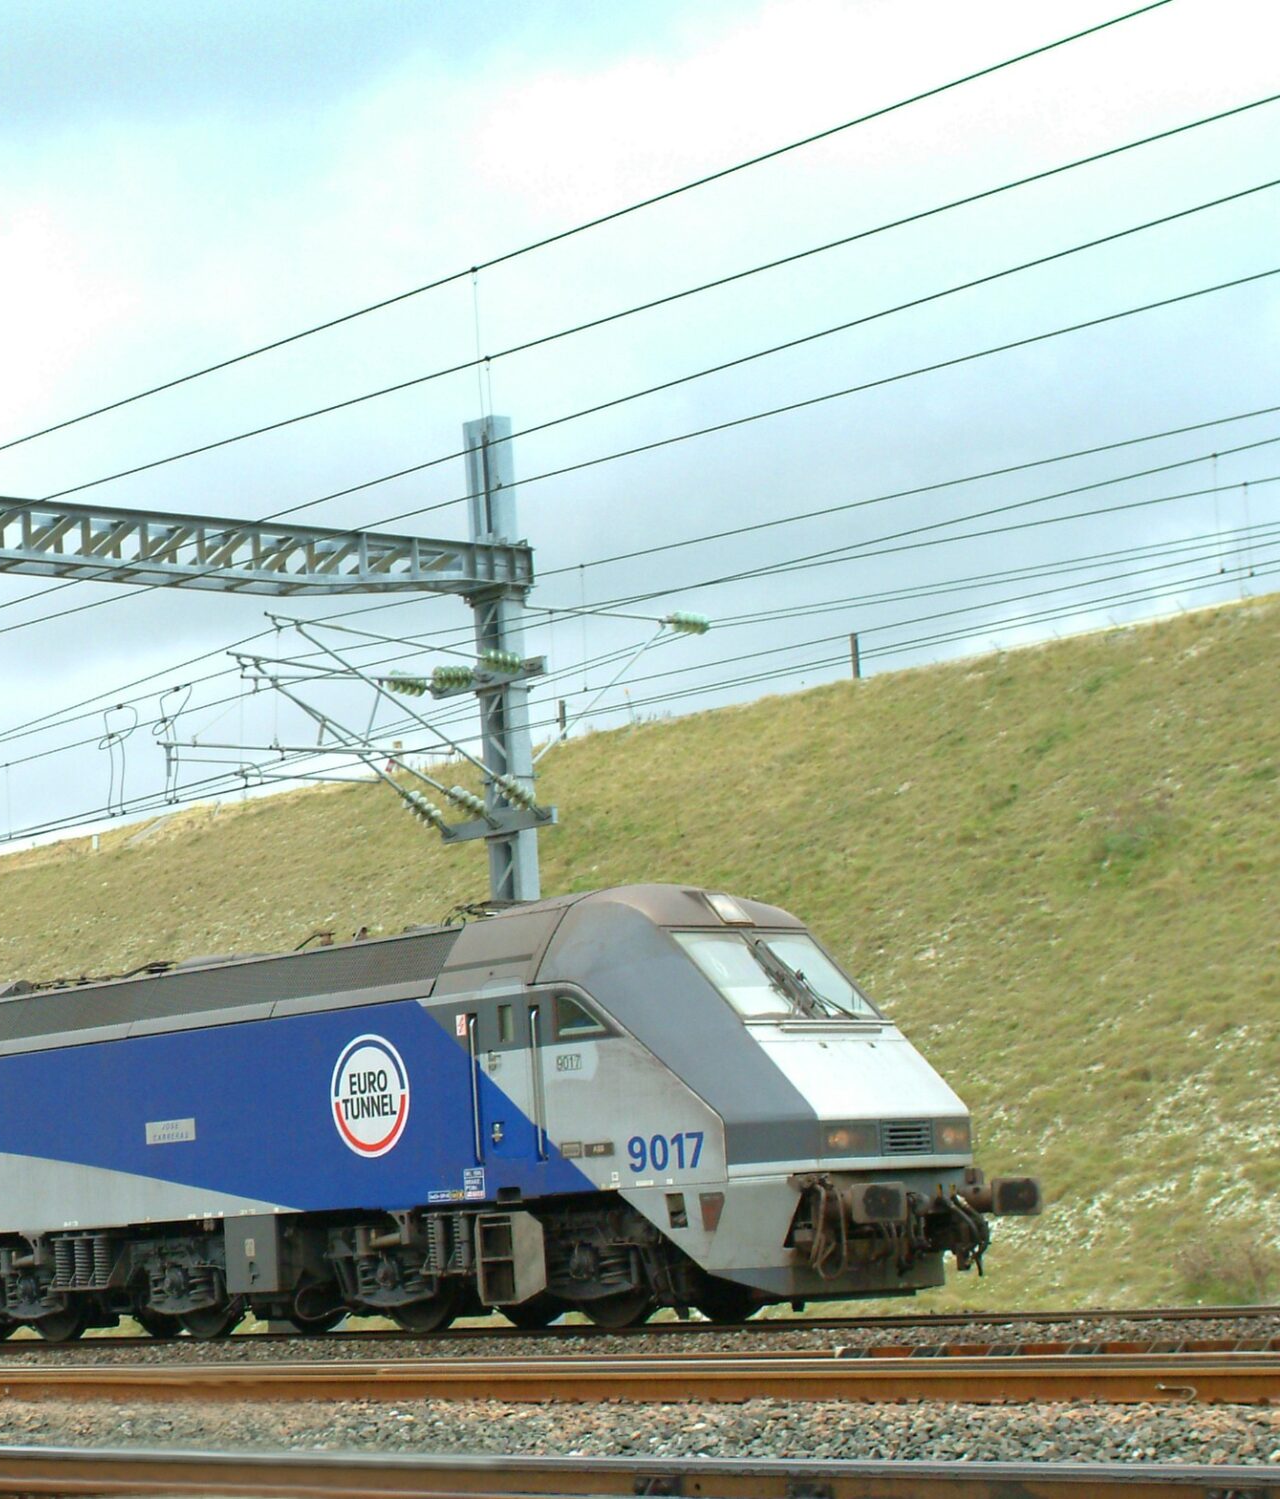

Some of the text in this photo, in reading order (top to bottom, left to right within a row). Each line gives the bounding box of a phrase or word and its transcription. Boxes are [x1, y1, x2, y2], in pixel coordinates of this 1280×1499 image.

[556, 1054, 581, 1072] 9017
[348, 1070, 387, 1096] EURO
[341, 1094, 397, 1121] TUNNEL
[628, 1131, 704, 1173] 9017
